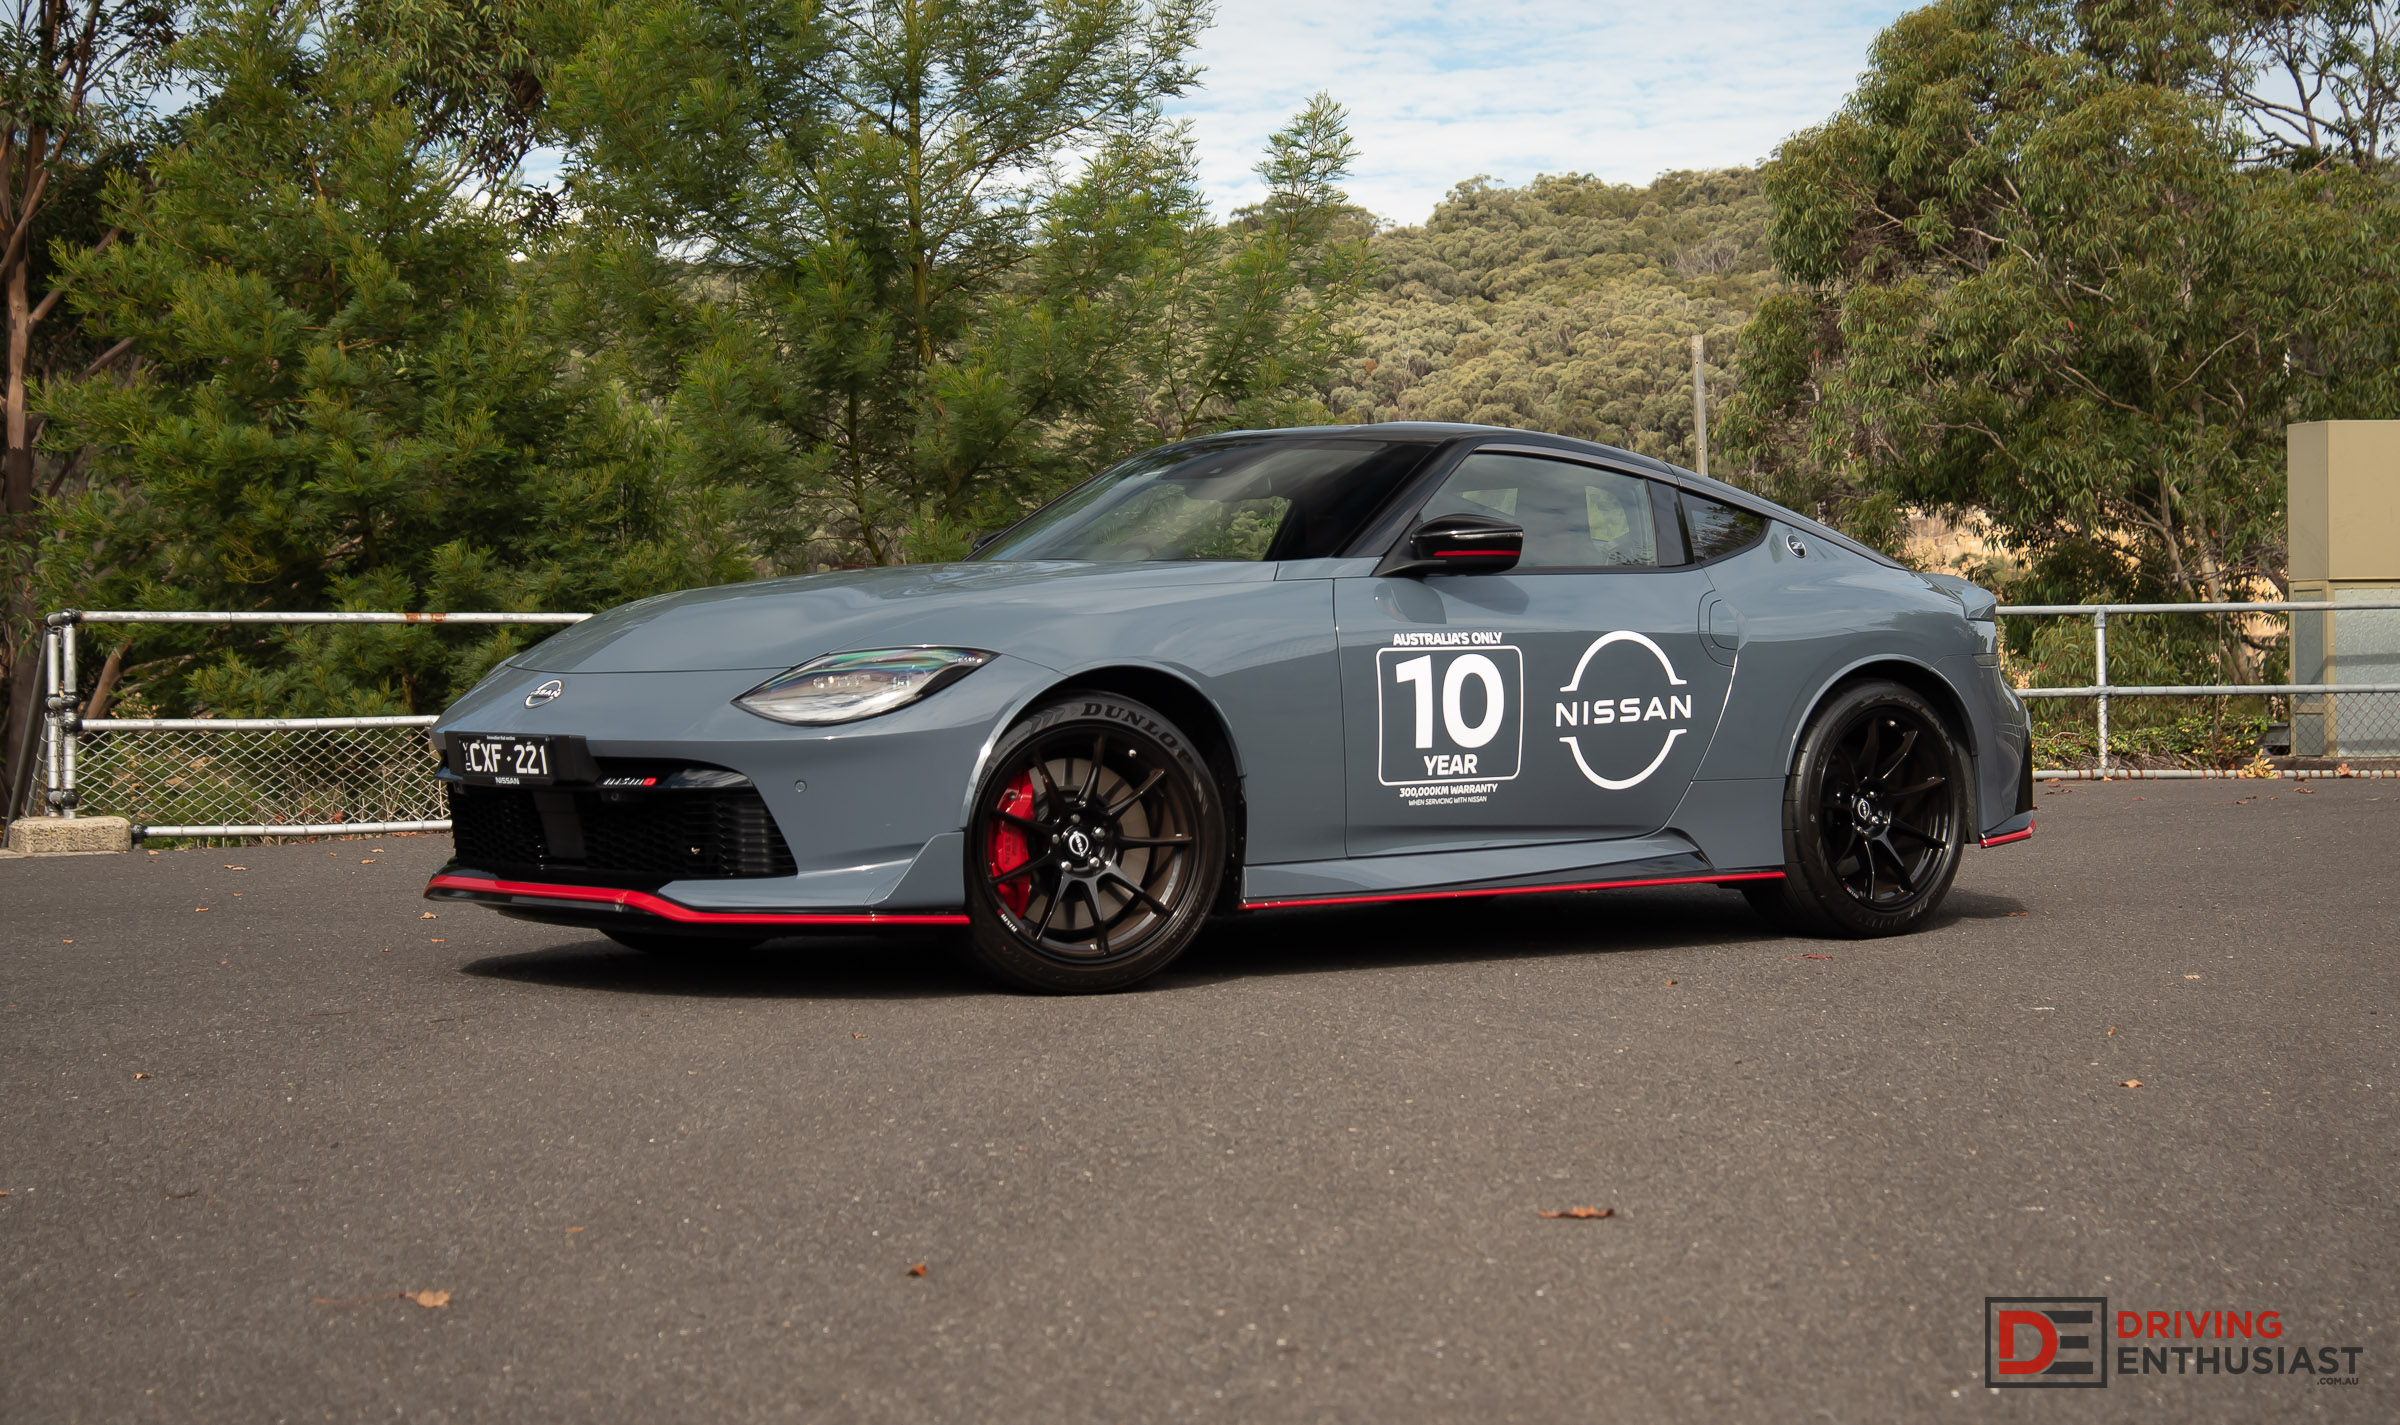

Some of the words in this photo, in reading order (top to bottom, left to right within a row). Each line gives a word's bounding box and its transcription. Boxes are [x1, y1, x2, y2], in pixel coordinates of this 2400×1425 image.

[1392, 631, 1470, 646] AUSTRALIA'S
[1471, 631, 1503, 645] ONLY
[1395, 653, 1505, 750] 10
[1555, 694, 1692, 728] NISSAN
[1080, 702, 1194, 764] DUNLOP
[1423, 754, 1478, 776] YEAR
[495, 776, 520, 785] NISSAN
[1399, 785, 1449, 798] 300,000KM
[1450, 783, 1498, 795] WARRANTY
[1425, 797, 1453, 806] SERVICING
[1453, 796, 1467, 804] WITH
[1467, 795, 1487, 803] NISSAN
